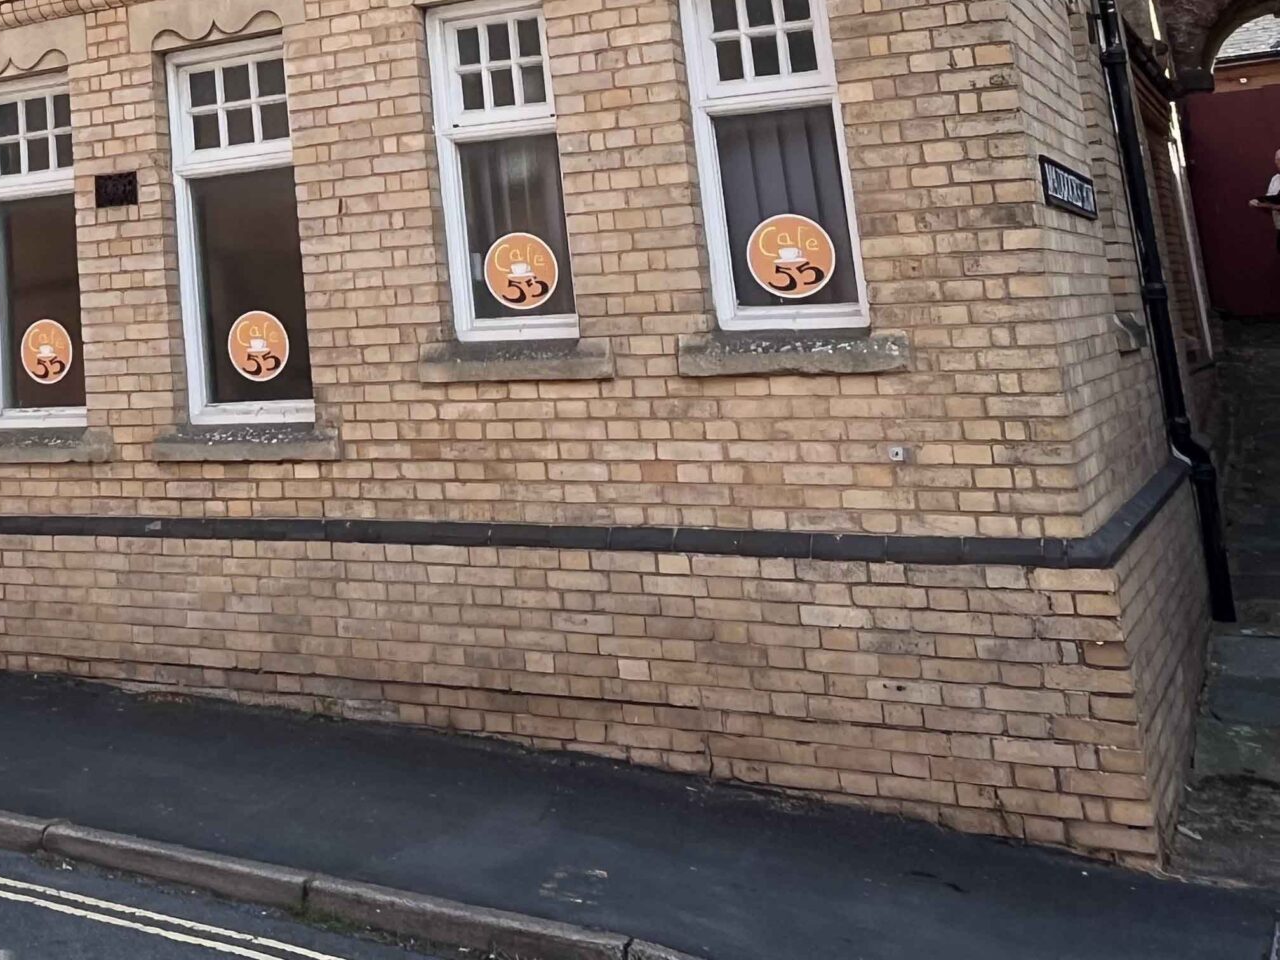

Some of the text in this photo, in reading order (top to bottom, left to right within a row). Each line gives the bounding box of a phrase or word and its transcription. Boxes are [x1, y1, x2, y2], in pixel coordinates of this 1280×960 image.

[759, 226, 819, 257] Cafe
[494, 243, 545, 272] Cafe
[502, 276, 549, 304] 55
[768, 261, 825, 292] 55
[236, 320, 279, 347] Cafe
[32, 356, 66, 379] 55
[242, 351, 281, 376] 55
